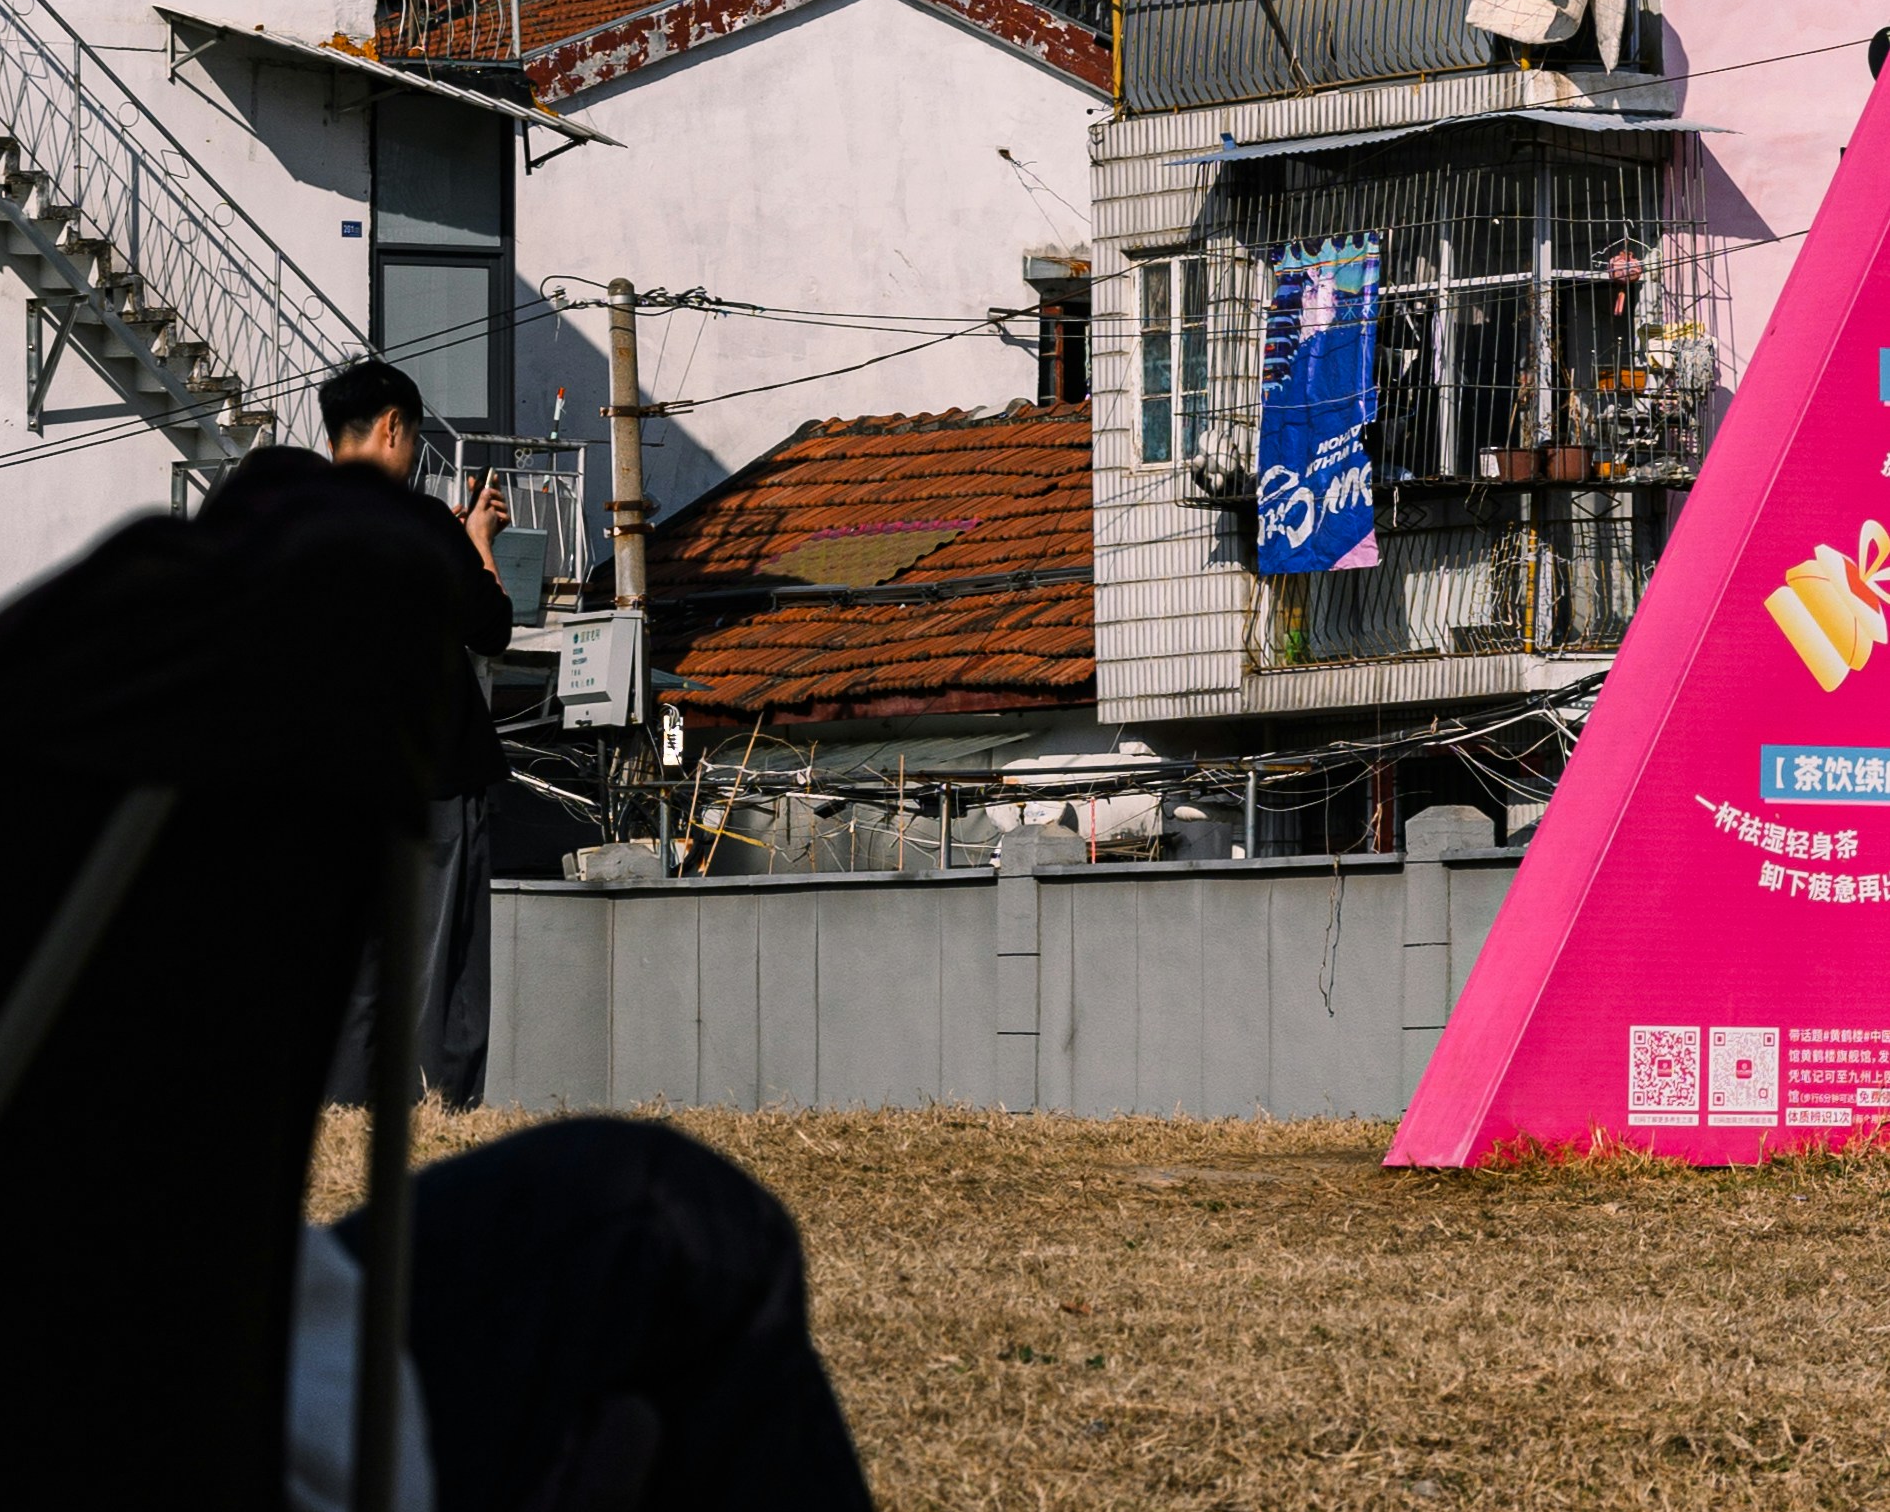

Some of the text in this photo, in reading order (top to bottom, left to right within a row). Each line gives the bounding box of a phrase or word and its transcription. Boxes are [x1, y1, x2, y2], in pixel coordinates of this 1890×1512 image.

[1316, 423, 1364, 456] ATHON
[1775, 754, 1890, 794] 【茶饮续
[1695, 794, 1859, 860] 一杯祛湿轻身茶
